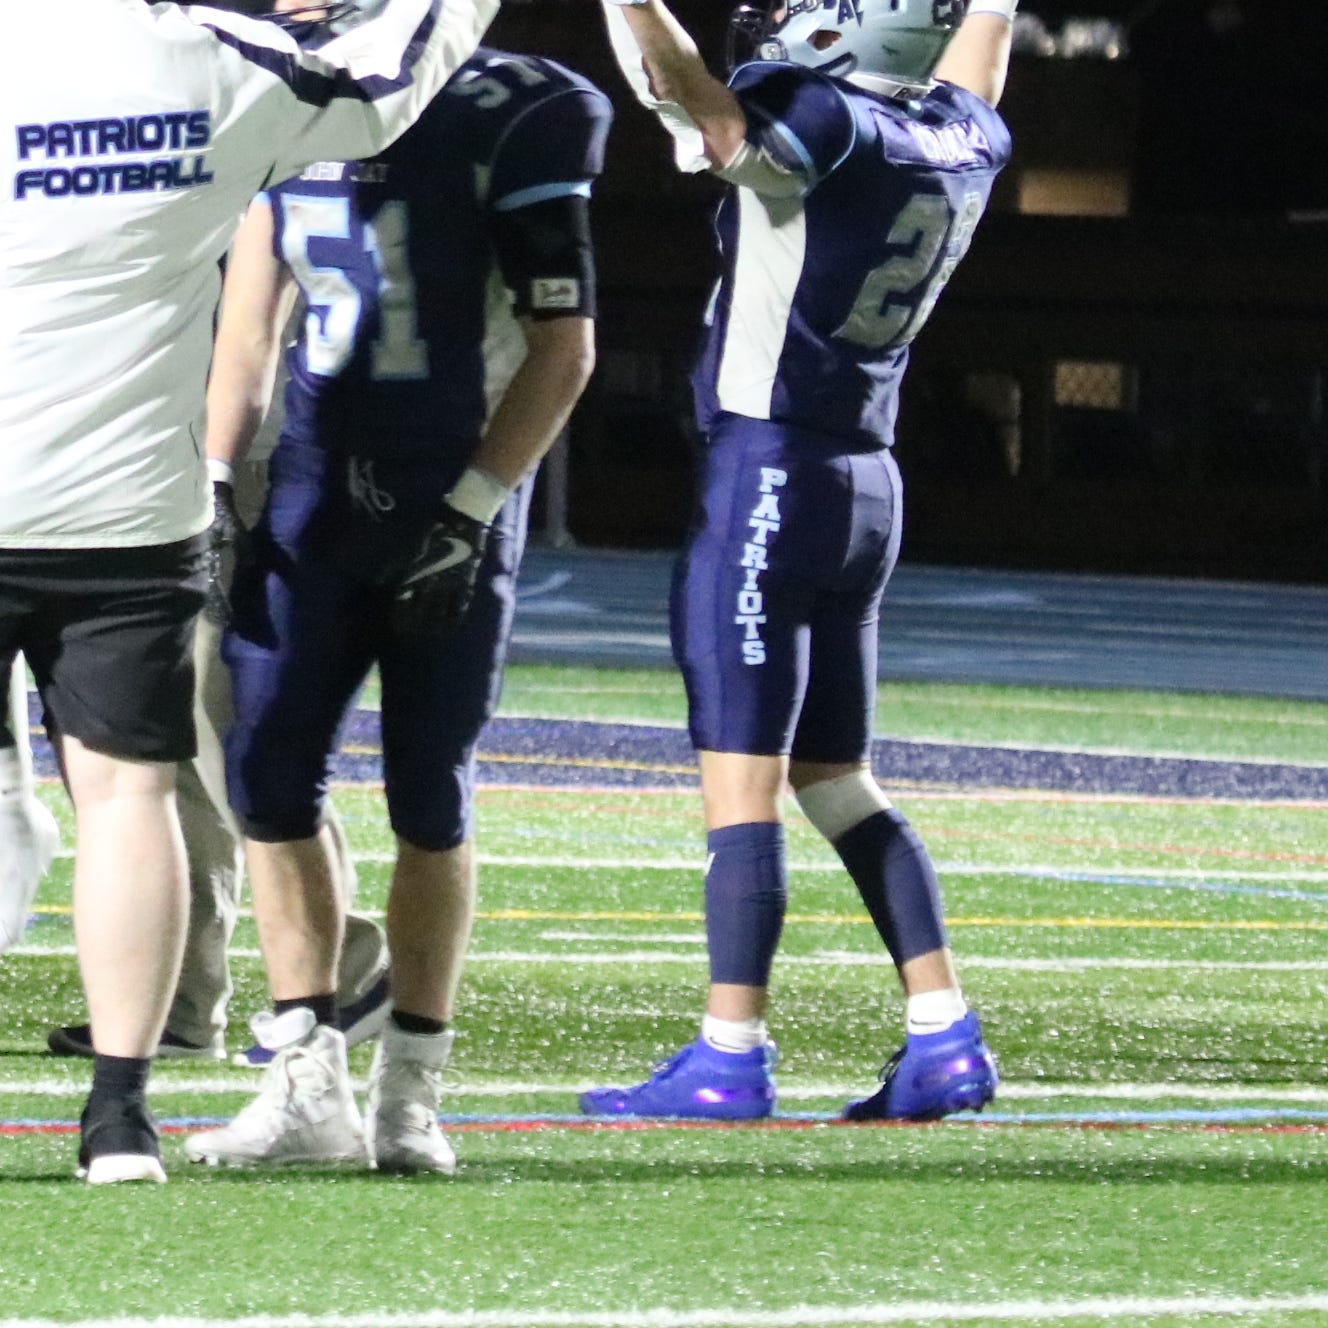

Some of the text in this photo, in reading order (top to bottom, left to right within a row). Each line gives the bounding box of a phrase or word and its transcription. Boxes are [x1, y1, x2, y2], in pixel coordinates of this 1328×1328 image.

[13, 154, 216, 202] FOOTBALL
[14, 108, 212, 162] PATRIOTS
[279, 192, 434, 383] 51
[734, 466, 789, 666] PATRIOTS
